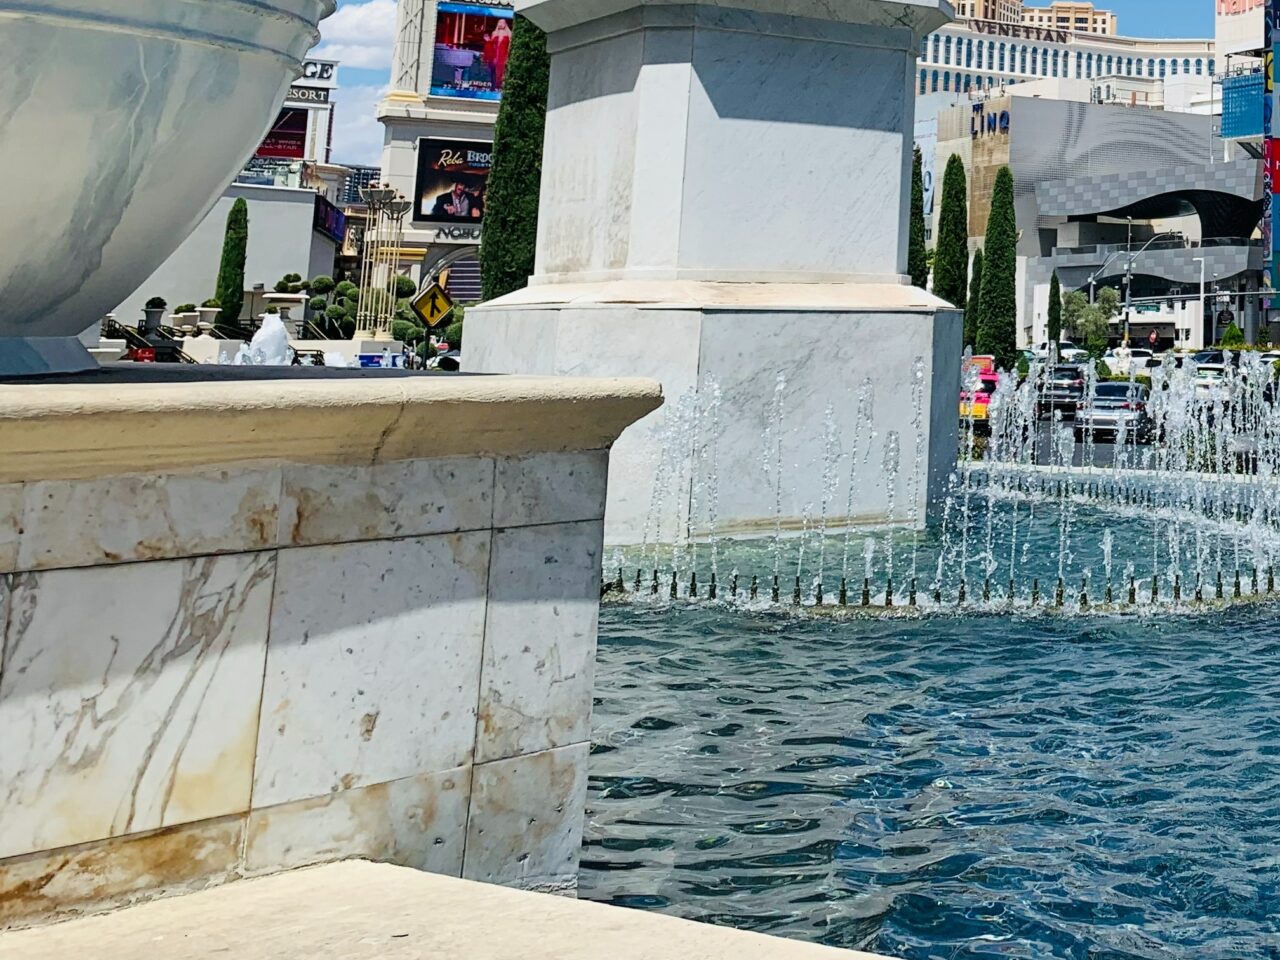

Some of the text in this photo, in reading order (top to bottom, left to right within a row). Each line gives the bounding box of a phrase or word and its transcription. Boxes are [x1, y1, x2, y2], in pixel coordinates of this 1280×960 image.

[973, 21, 1068, 44] VENETIAN
[970, 110, 1010, 134] LINQ
[438, 149, 464, 166] Reba
